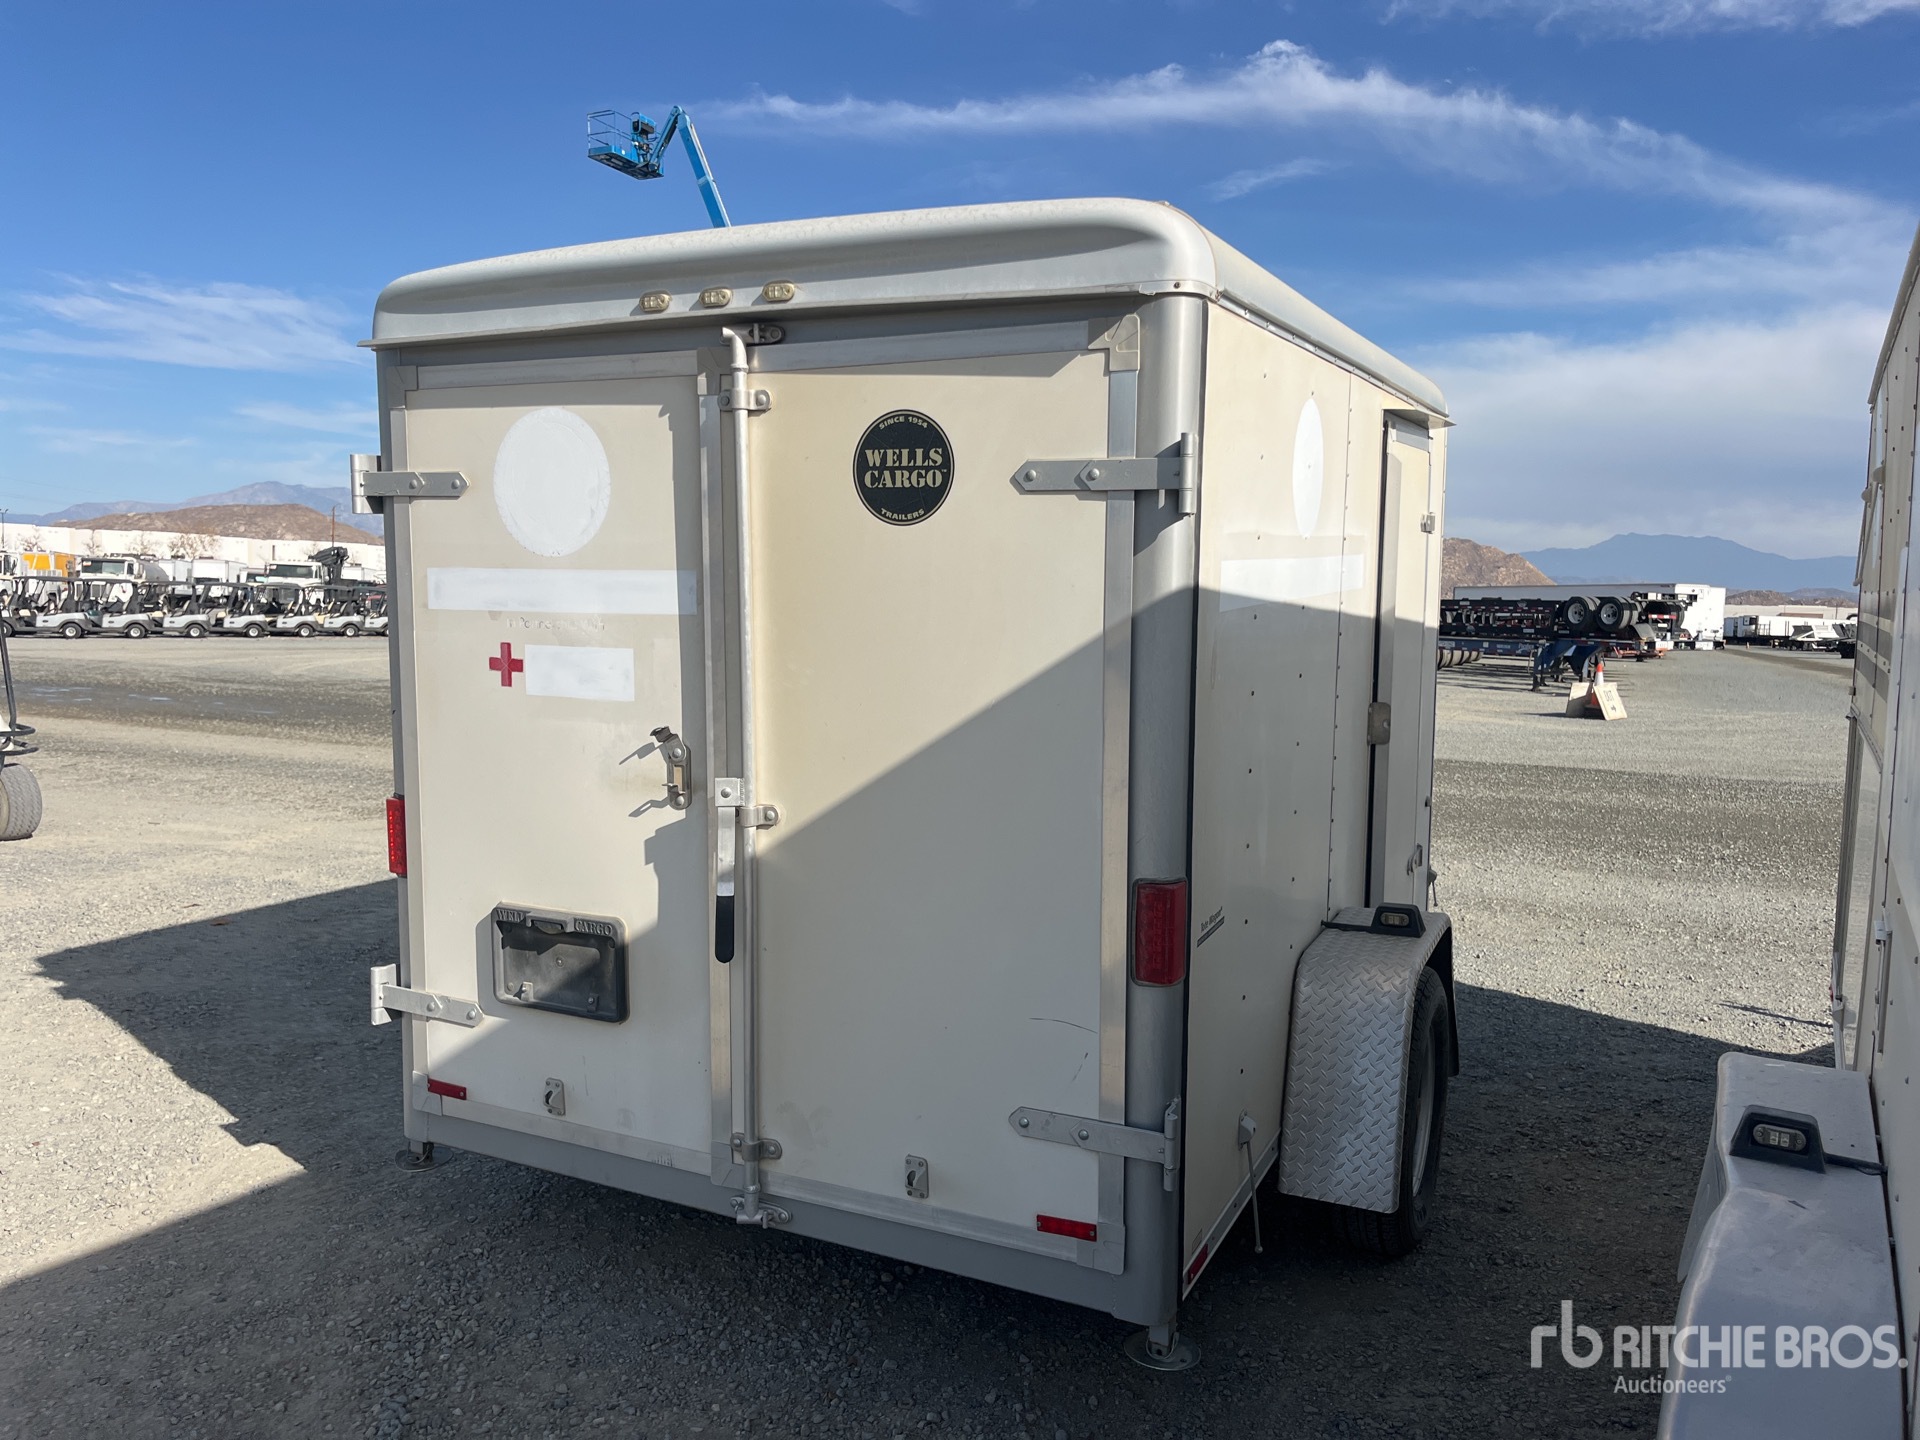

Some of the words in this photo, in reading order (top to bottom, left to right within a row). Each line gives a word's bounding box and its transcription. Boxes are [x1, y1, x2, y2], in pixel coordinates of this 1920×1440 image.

[879, 416, 905, 430] SINCE
[908, 416, 928, 429] 1954
[864, 447, 943, 467] WELLS
[881, 507, 925, 520] TRAILERS
[496, 909, 525, 922] WELL
[575, 919, 613, 936] CARGO
